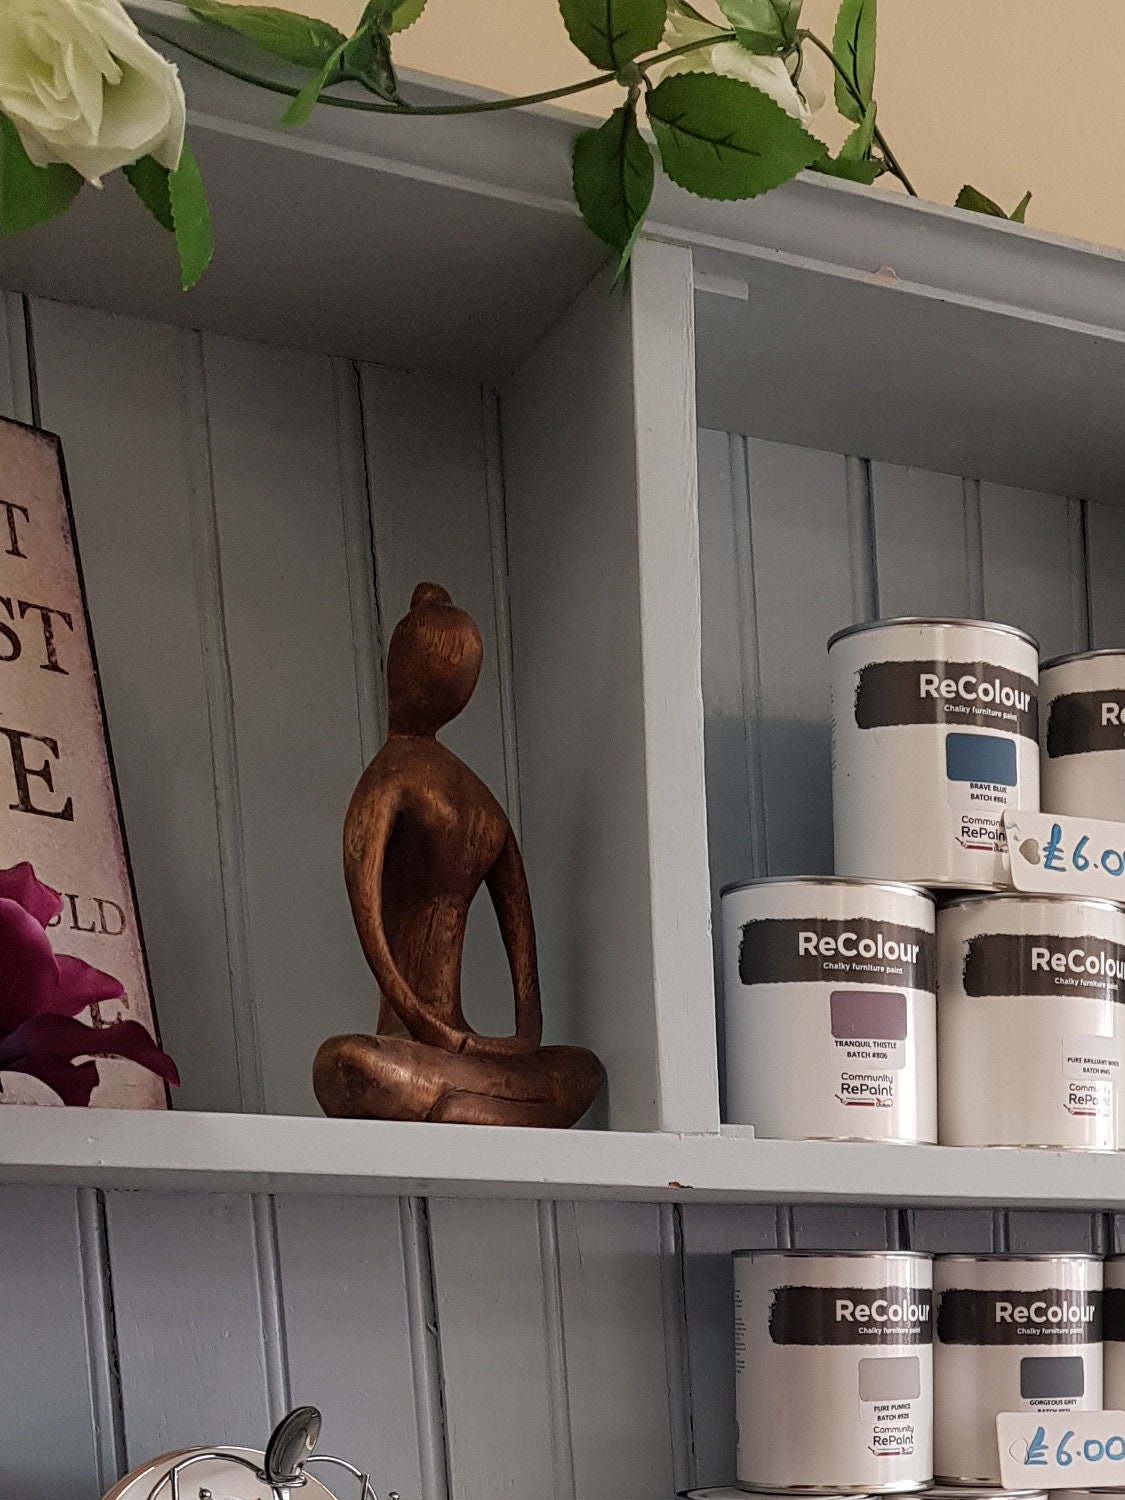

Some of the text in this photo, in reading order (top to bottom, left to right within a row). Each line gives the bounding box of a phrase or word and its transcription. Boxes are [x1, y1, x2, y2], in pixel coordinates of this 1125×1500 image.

[920, 673, 1030, 712] ReColour
[944, 704, 970, 713] Chalky
[972, 707, 1002, 718] furniture
[970, 783, 1008, 793] BRAVE BLUE
[970, 793, 992, 801] BATCH
[798, 931, 919, 964] ReColour
[823, 962, 850, 972] Chalky
[852, 963, 885, 973] furniture
[1054, 977, 1079, 986] Chalky
[1080, 979, 1106, 988] furniture
[834, 1041, 897, 1049] TRANQUIL THISTLE
[846, 1051, 871, 1059] BATCH
[841, 1072, 893, 1084] Community
[841, 1083, 893, 1096] RePaint
[836, 1300, 930, 1322] ReColour
[995, 1301, 1095, 1323] ReColour
[859, 1327, 882, 1335] Chalky
[873, 1425, 914, 1434] Community
[873, 1435, 914, 1446] RePaint
